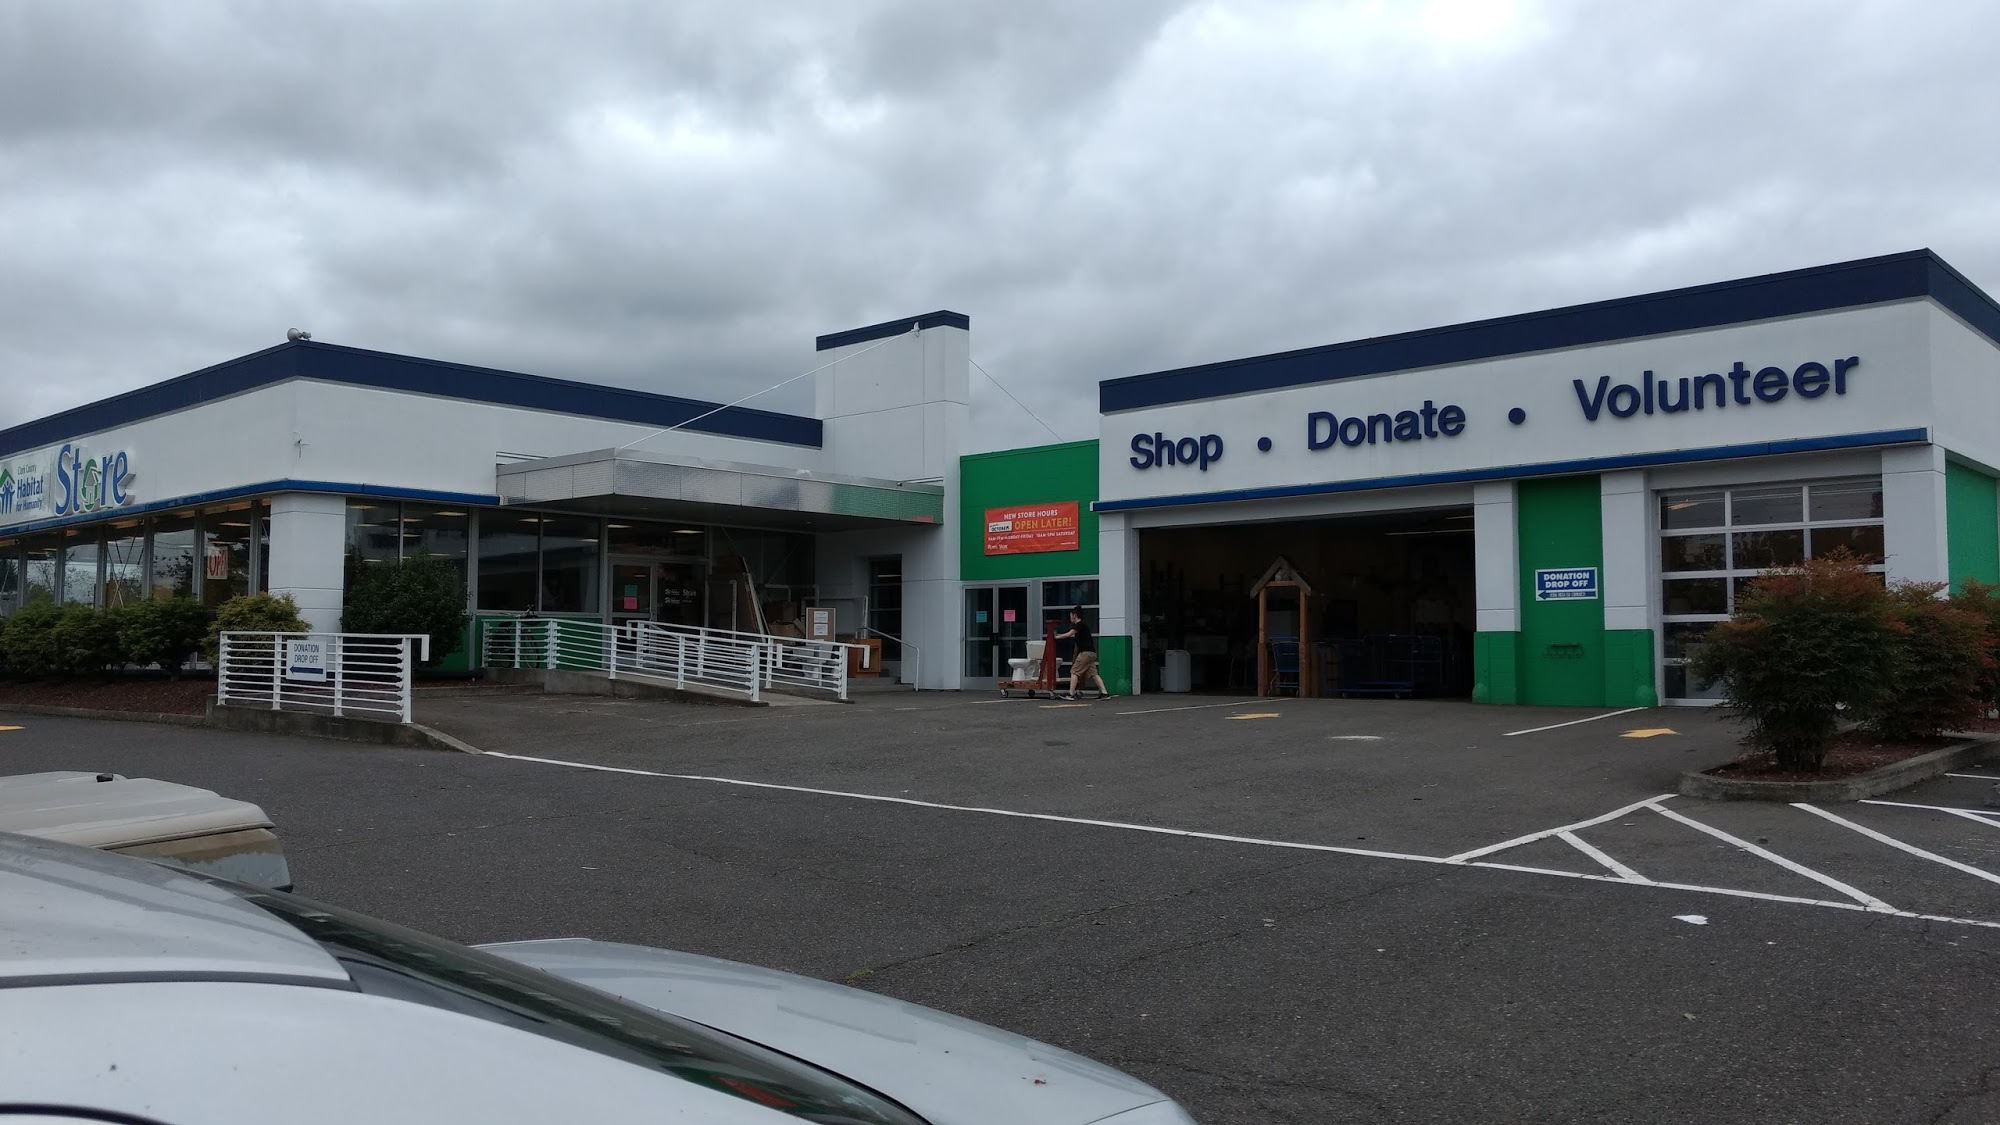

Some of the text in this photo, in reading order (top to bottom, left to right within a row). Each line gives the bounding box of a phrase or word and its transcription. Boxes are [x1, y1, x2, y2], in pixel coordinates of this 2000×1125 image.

[1129, 355, 1860, 473] Shop Donate Volunteer
[55, 443, 128, 516] Store
[17, 476, 43, 498] Habitat
[23, 499, 42, 511] Humanity
[1017, 511, 1036, 519] STORE
[1037, 509, 1058, 517] HOURS
[1014, 517, 1072, 530] OPEN LATER!
[1543, 572, 1590, 580] DONATION
[1545, 580, 1589, 588] DROP OFF
[294, 644, 319, 652] DONATION
[295, 655, 319, 663] DROP OFF
